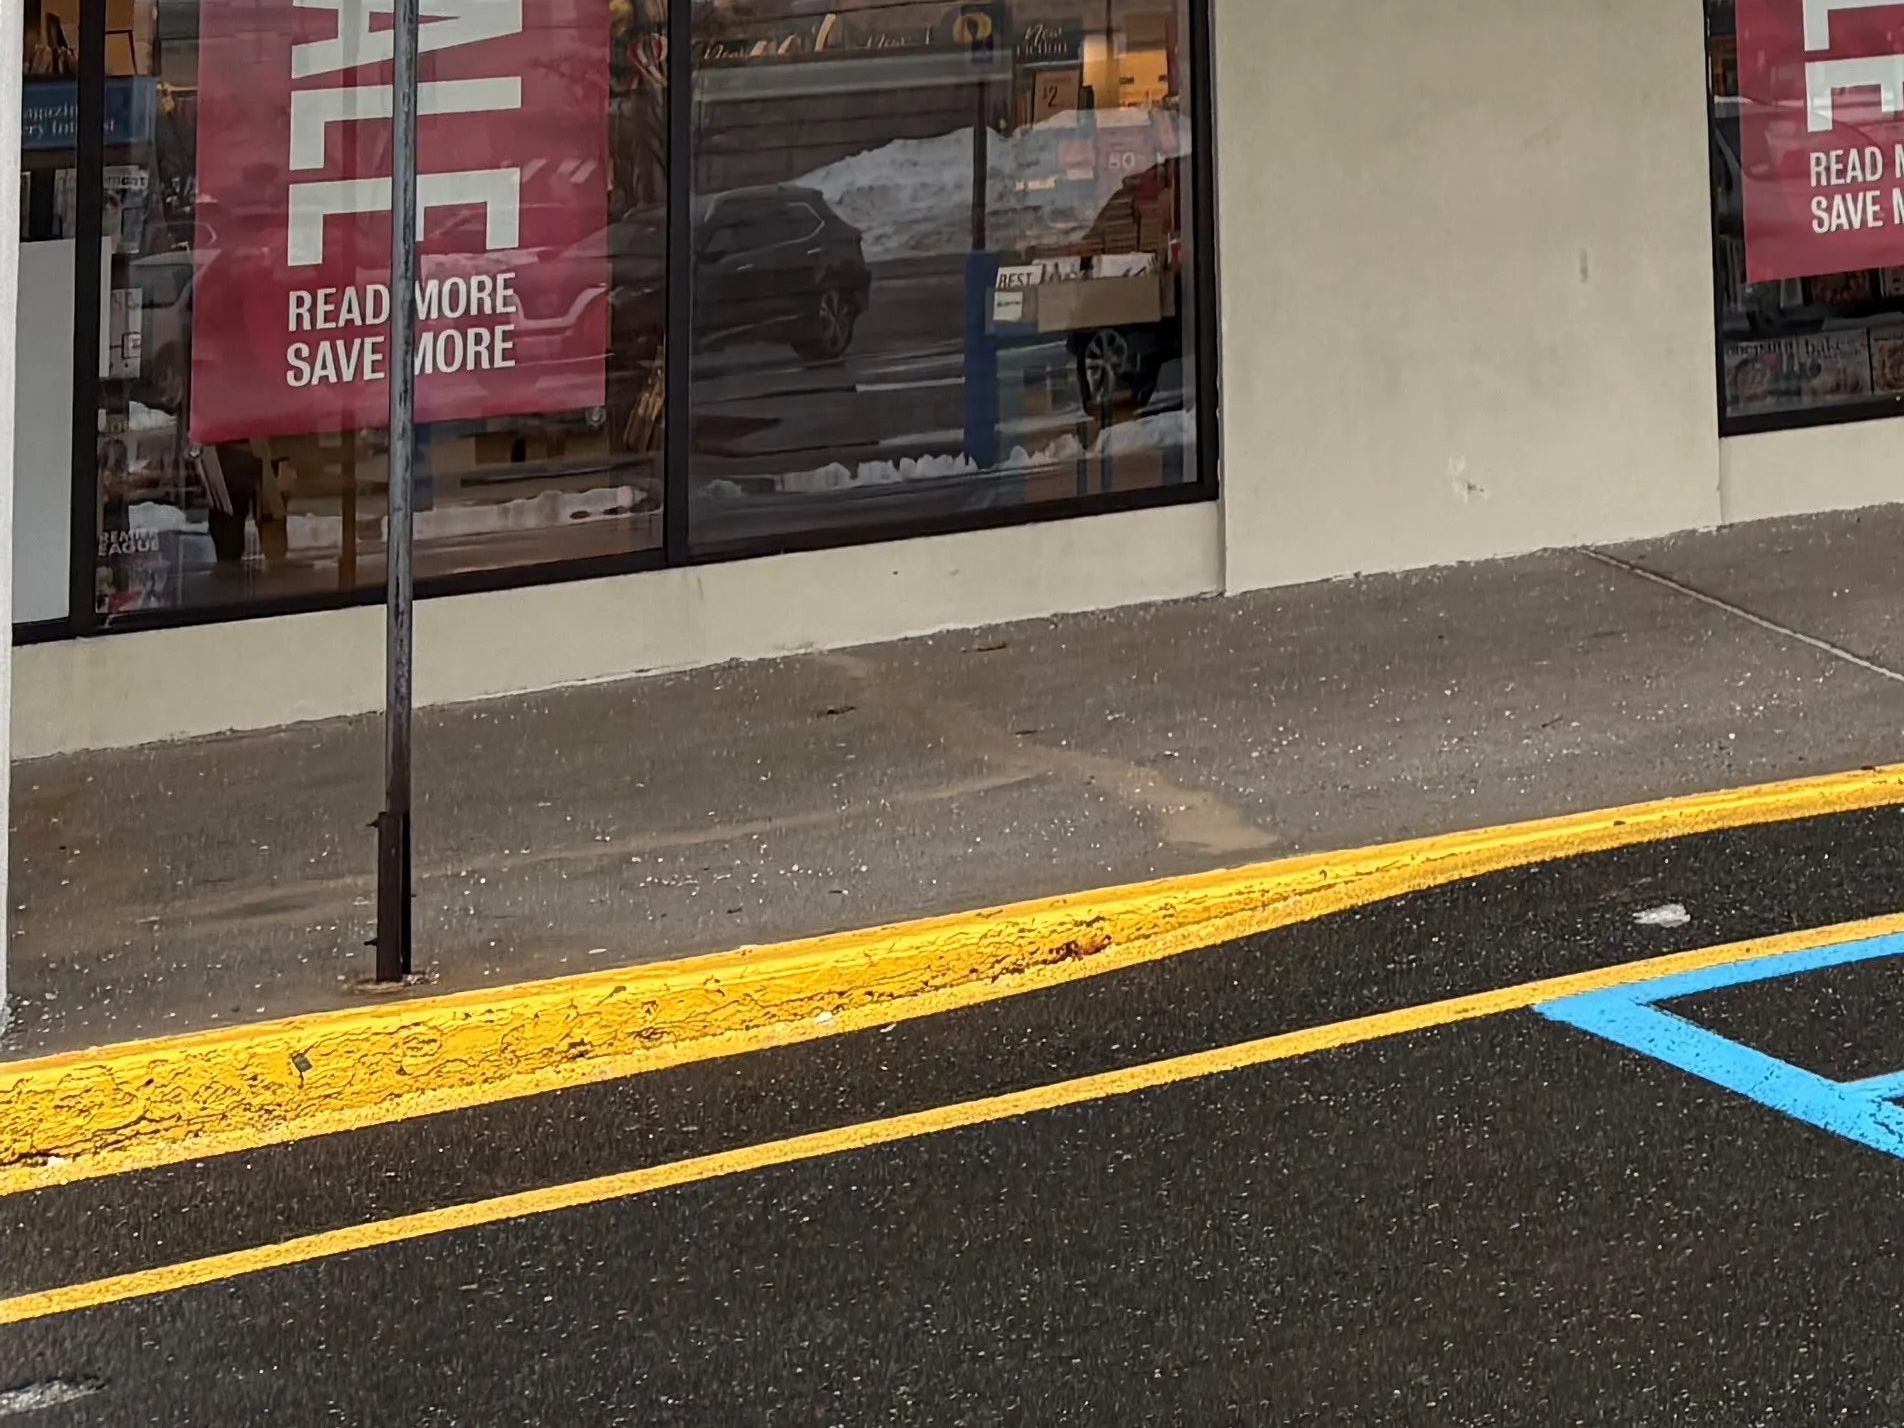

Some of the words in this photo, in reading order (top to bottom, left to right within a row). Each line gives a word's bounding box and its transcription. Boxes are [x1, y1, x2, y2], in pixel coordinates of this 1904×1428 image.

[1809, 146, 1883, 188] READ
[1811, 190, 1884, 235] SAVE
[287, 283, 391, 333] READ
[414, 272, 517, 321] MORE
[286, 335, 385, 388] SAVE
[413, 324, 517, 376] MORE
